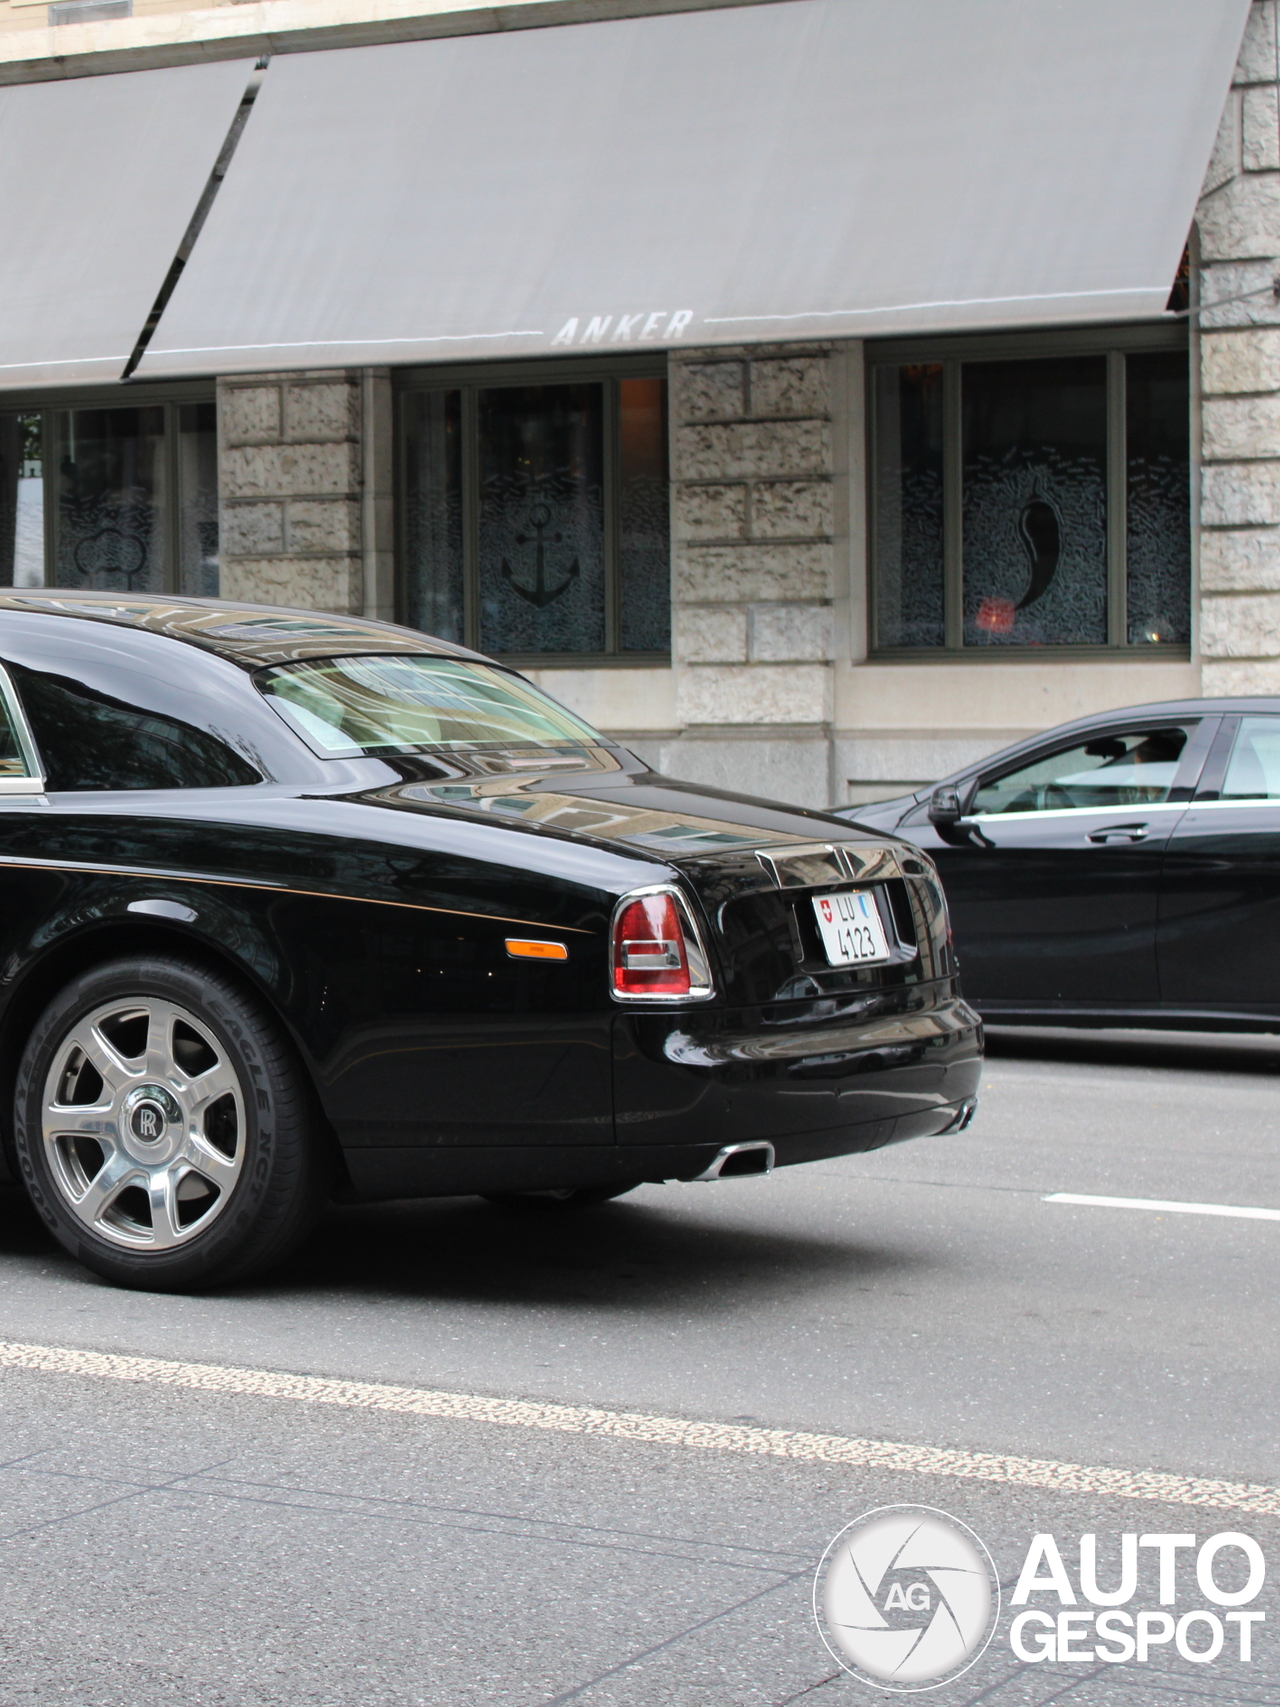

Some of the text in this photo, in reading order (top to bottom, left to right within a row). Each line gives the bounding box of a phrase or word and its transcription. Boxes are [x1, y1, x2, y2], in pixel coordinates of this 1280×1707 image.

[550, 309, 694, 345] ANKER
[836, 897, 856, 922] LU
[837, 926, 876, 960] 4123
[206, 998, 271, 1113] EAGLE
